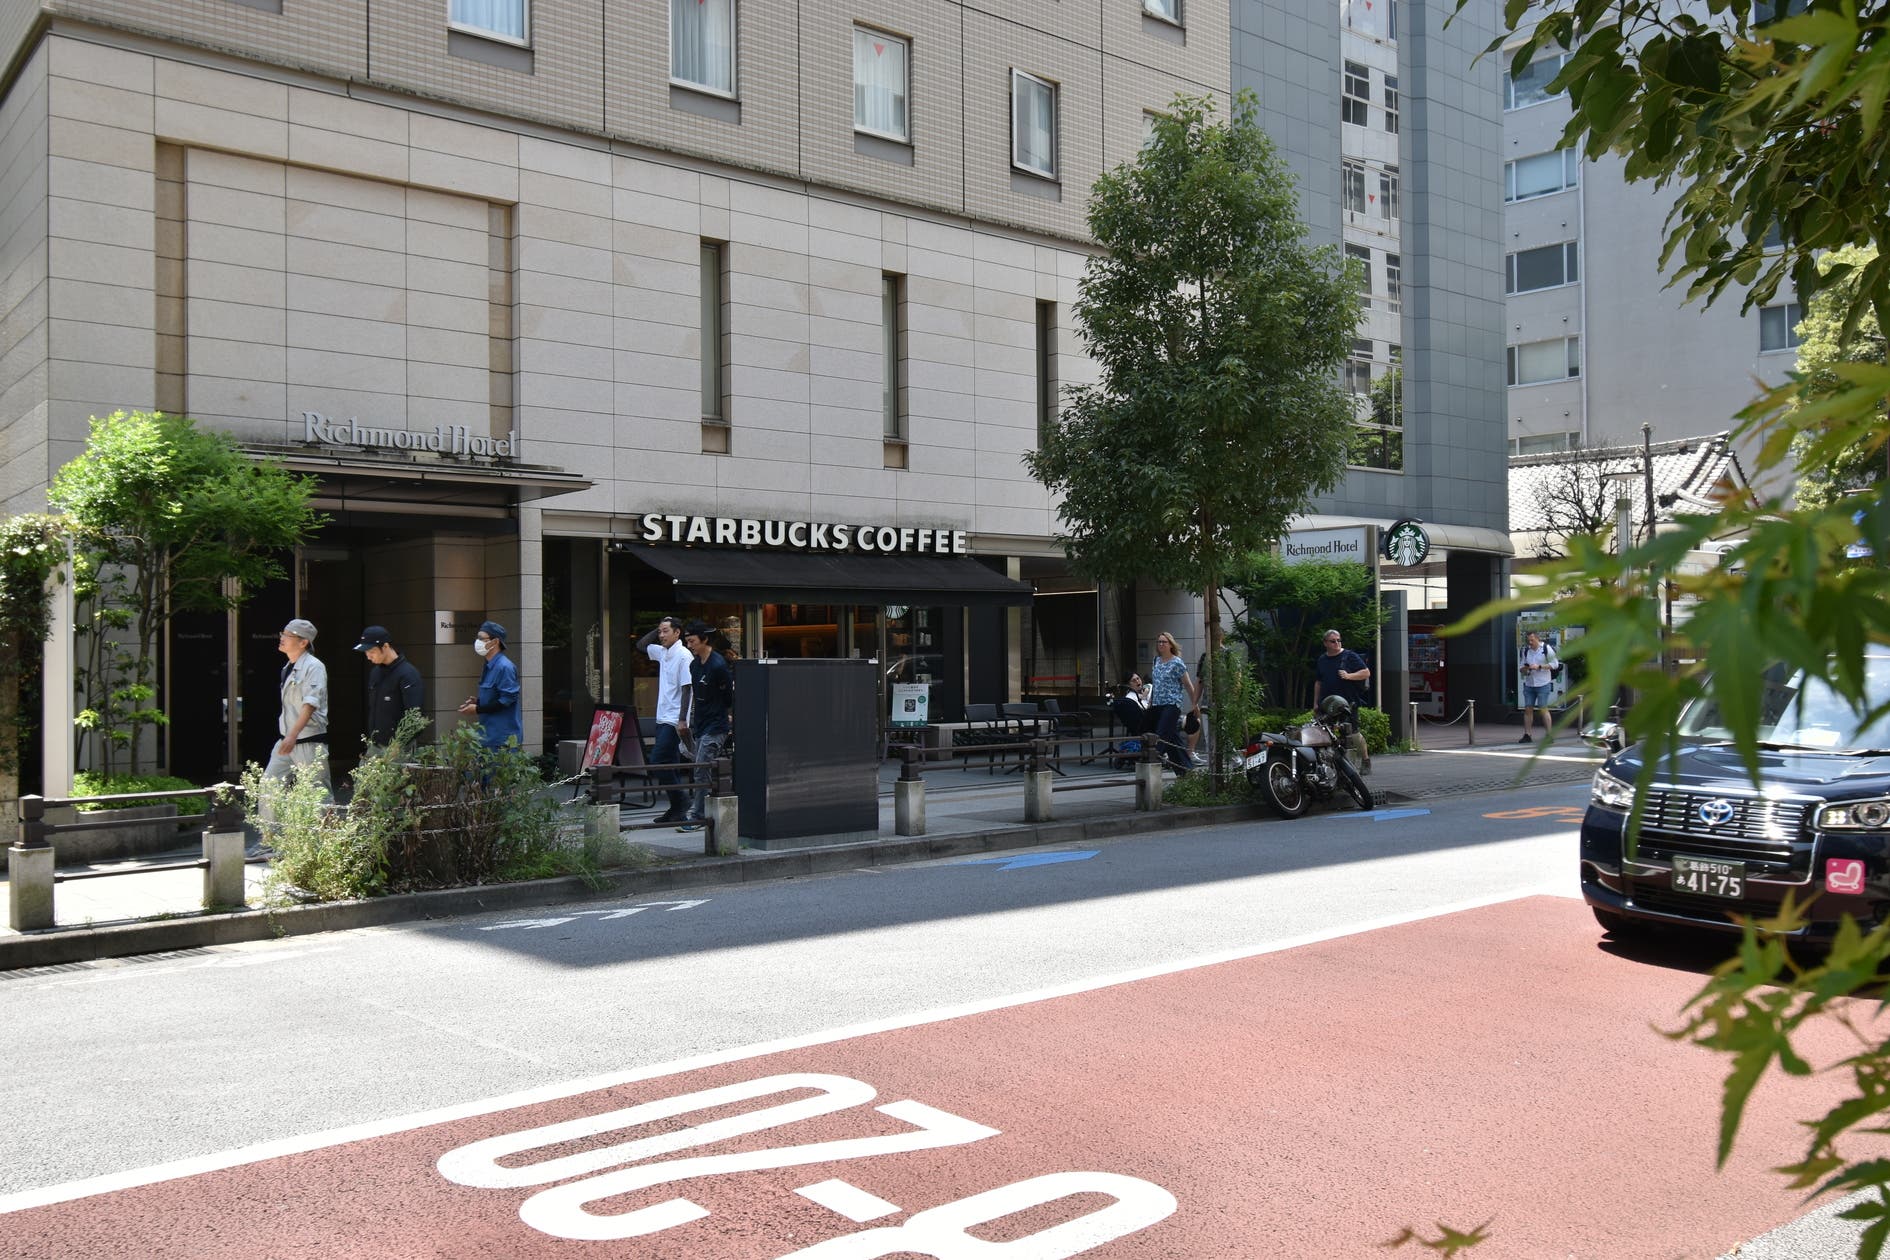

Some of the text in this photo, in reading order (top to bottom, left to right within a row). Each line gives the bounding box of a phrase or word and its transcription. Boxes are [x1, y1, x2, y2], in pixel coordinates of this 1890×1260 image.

[303, 411, 517, 457] Richmond Hotel
[642, 513, 967, 553] STARBUCKS COFFEE
[1286, 540, 1358, 556] Richmond Hotel
[1710, 863, 1729, 875] 510
[1676, 872, 1741, 897] あ 41-75
